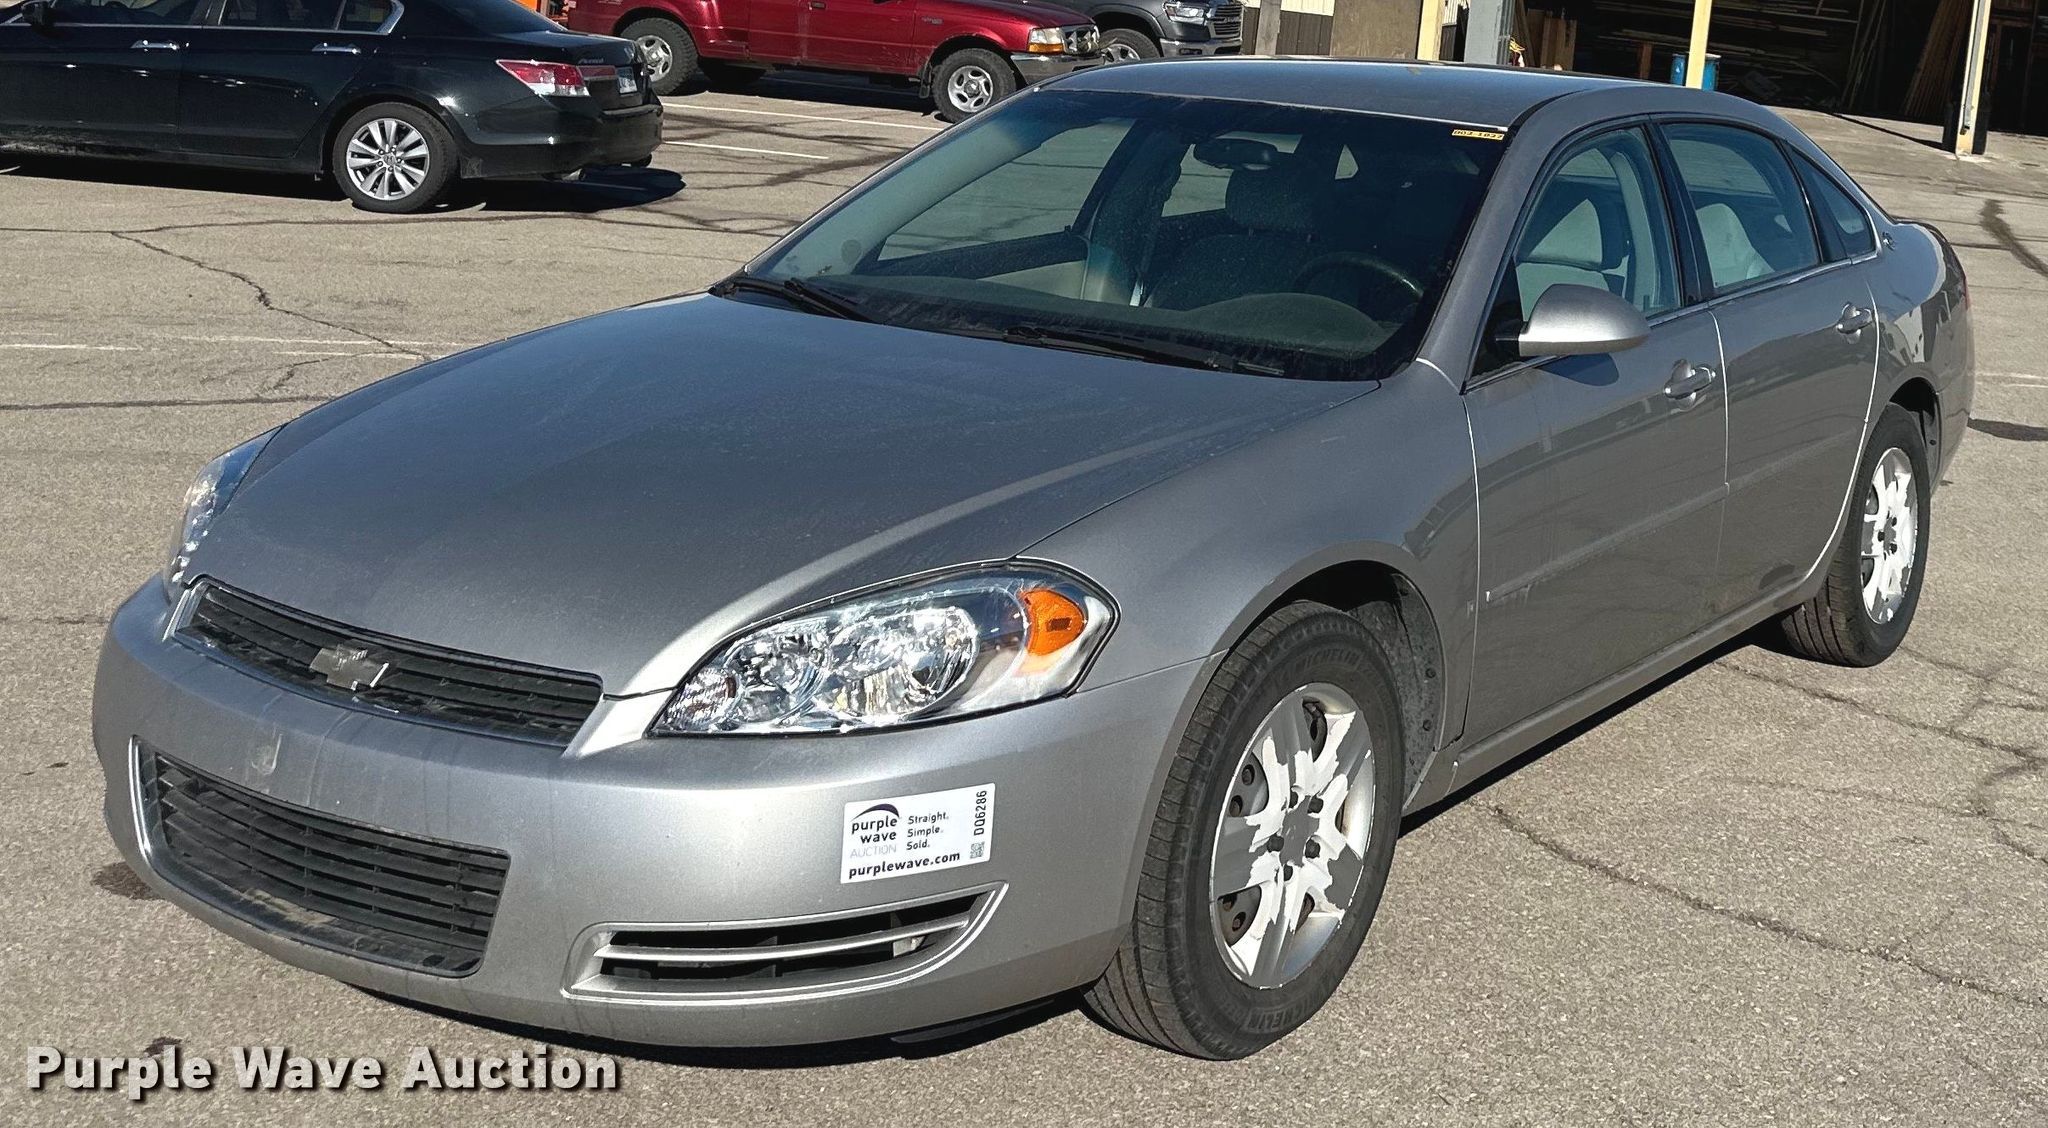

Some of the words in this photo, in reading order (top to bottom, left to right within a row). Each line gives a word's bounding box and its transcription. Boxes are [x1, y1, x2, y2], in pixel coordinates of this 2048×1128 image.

[908, 811, 949, 825] Straight.
[974, 790, 987, 836] DQ6286
[851, 815, 898, 834] purple
[860, 831, 897, 844] wave
[907, 826, 943, 838] Simple.
[850, 844, 897, 859] AUCTION
[906, 839, 930, 850] Sold.
[849, 852, 960, 879] purplewave.com
